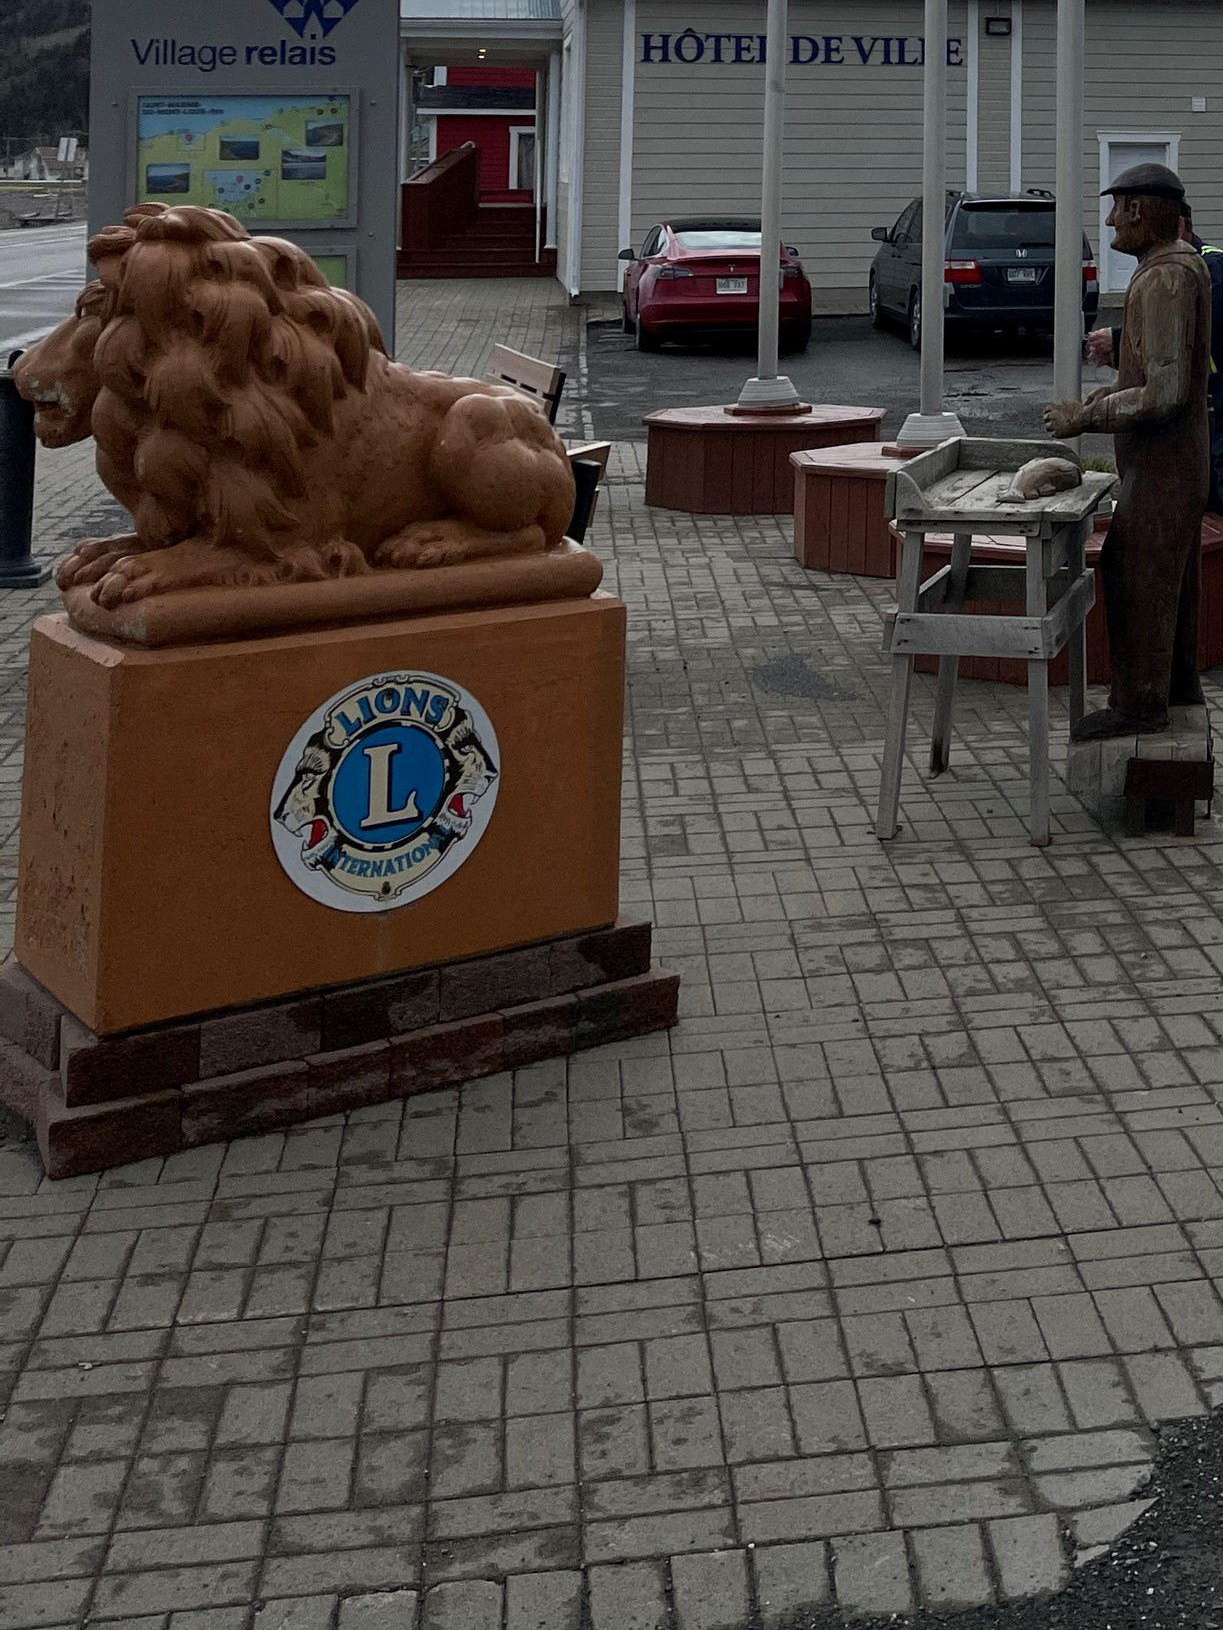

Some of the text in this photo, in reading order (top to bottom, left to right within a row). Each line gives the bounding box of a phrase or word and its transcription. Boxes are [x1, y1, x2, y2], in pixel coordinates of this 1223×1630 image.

[131, 33, 336, 72] Village relais
[789, 35, 845, 65] DE
[335, 687, 449, 737] LIONS
[361, 743, 421, 829] L
